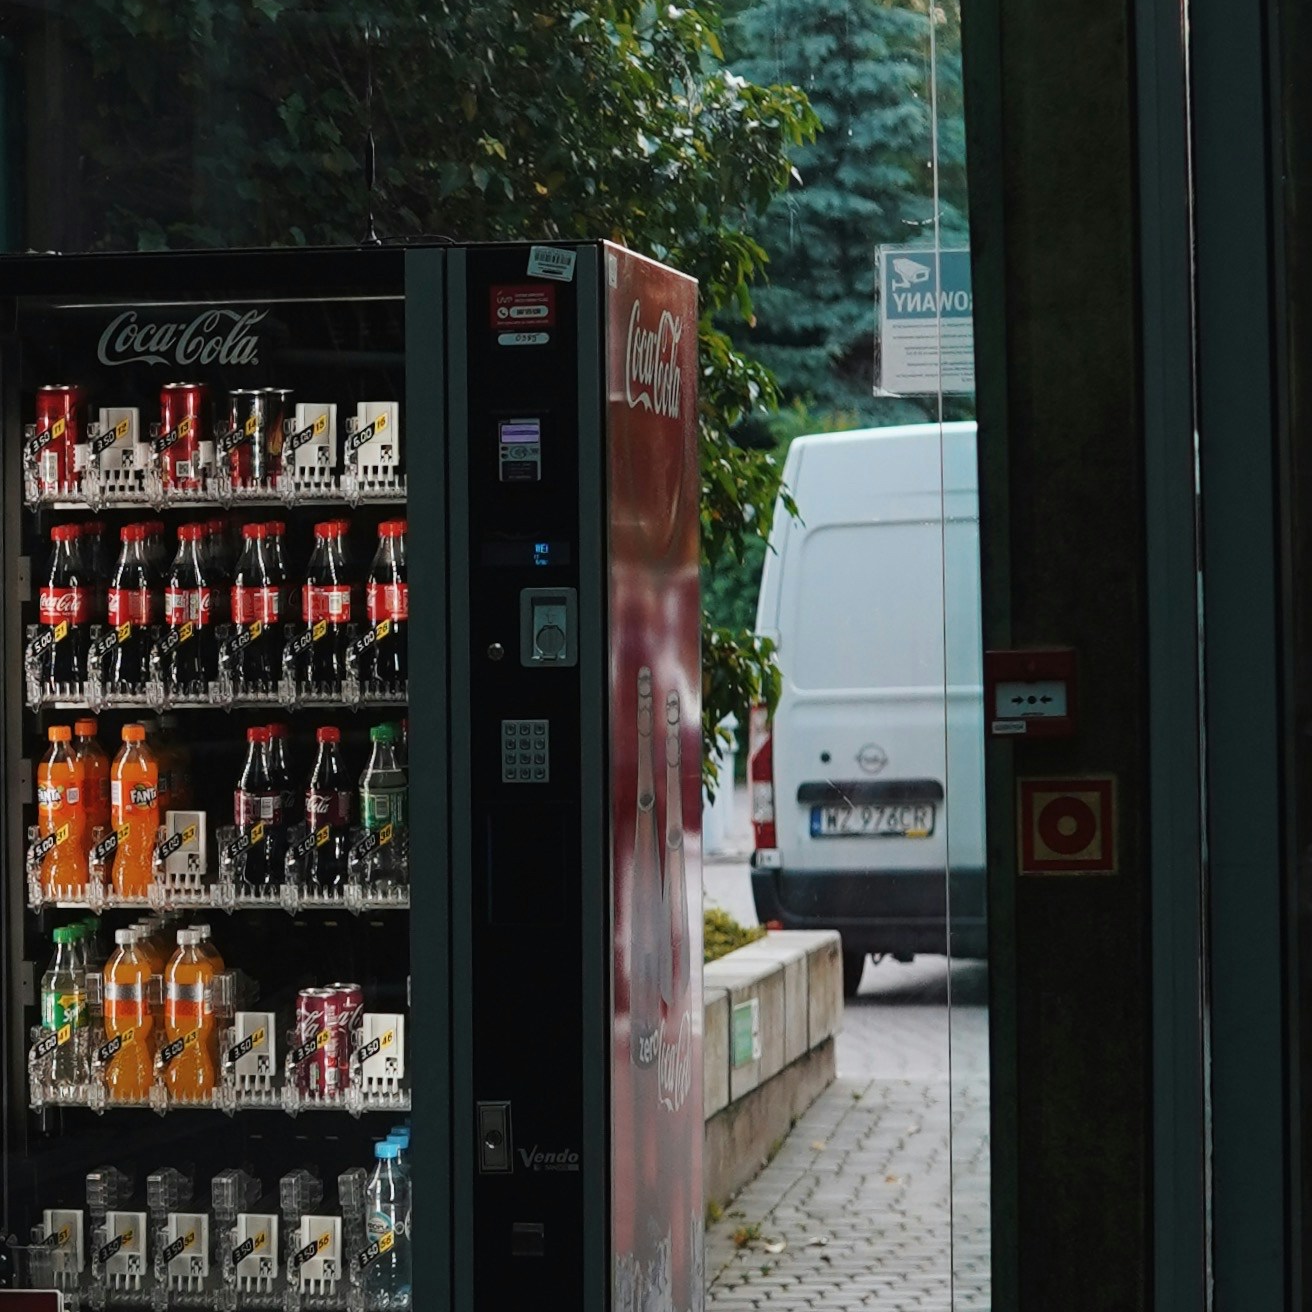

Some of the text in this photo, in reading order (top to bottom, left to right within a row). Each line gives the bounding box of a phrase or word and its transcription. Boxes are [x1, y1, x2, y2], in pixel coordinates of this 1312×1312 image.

[97, 308, 270, 367] Coca-Cola
[626, 298, 682, 420] Coca-Cola
[517, 1144, 579, 1168] Vendo
